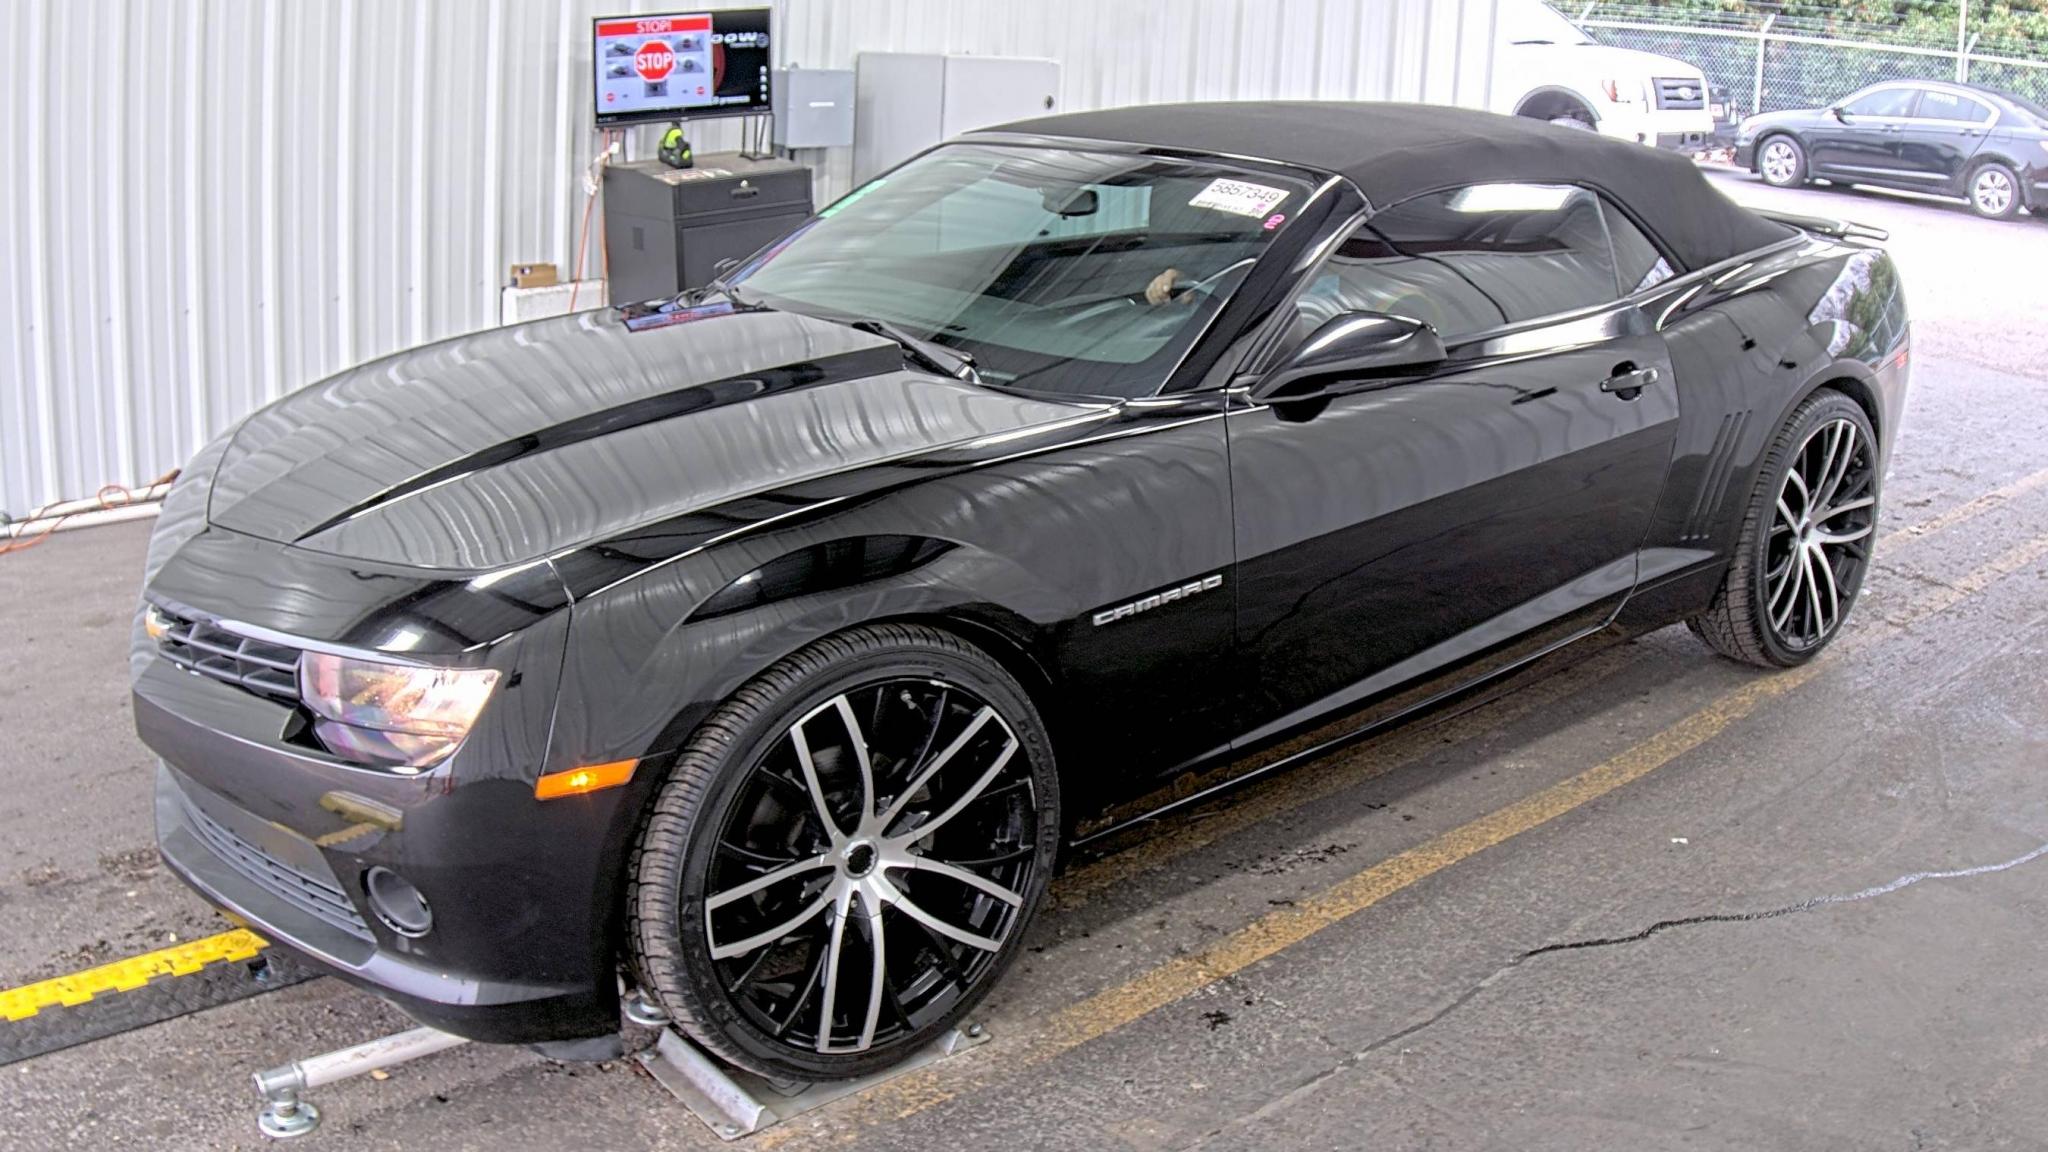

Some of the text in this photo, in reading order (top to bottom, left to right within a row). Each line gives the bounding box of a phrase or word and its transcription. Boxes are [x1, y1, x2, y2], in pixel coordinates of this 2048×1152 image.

[637, 52, 673, 70] STOP
[1211, 181, 1280, 203] 5857349
[1092, 574, 1223, 627] CAMARO
